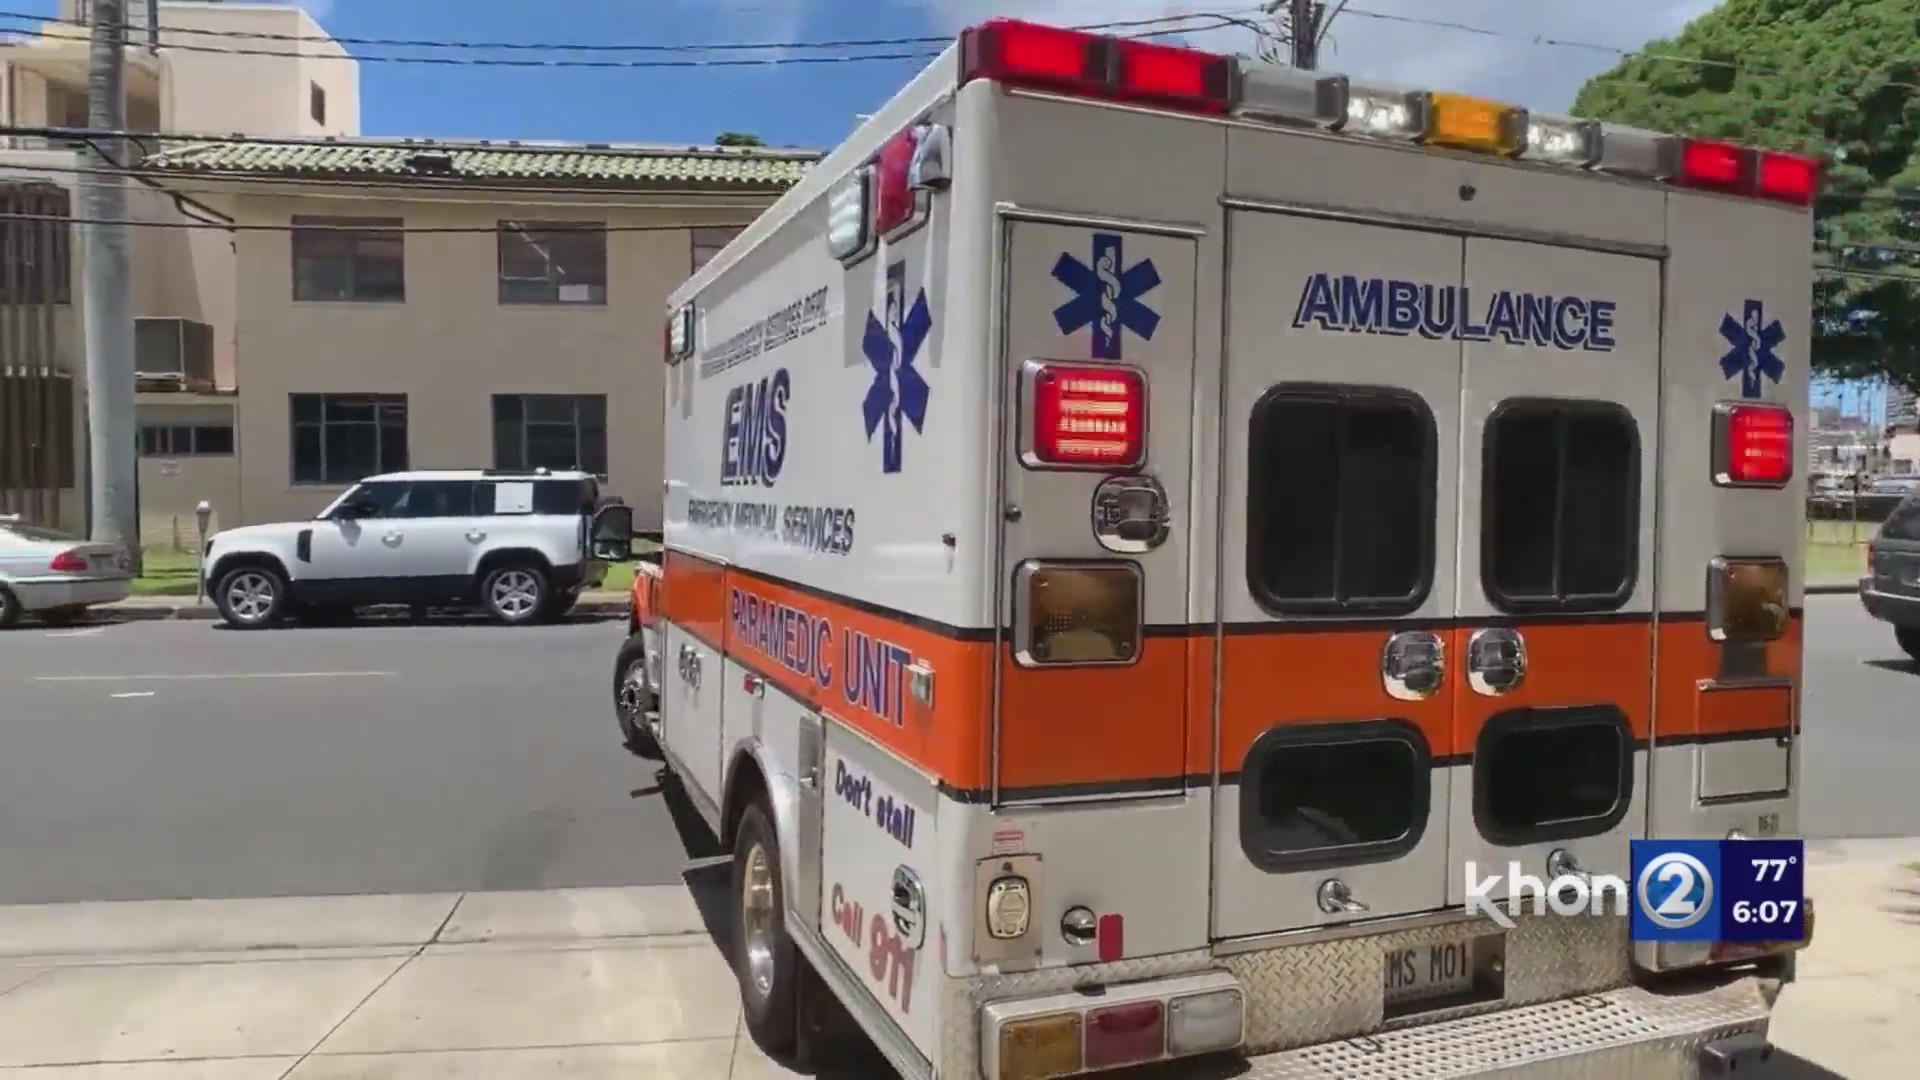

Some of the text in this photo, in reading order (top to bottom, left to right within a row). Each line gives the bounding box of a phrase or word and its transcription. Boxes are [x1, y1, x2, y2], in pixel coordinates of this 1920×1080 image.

[1291, 273, 1617, 353] AMBULANCE
[721, 367, 791, 489] EMS
[783, 504, 856, 557] SERVICES
[731, 586, 913, 729] PARAMEDIC UNIT
[835, 758, 872, 817] Don't
[832, 881, 864, 949] Call
